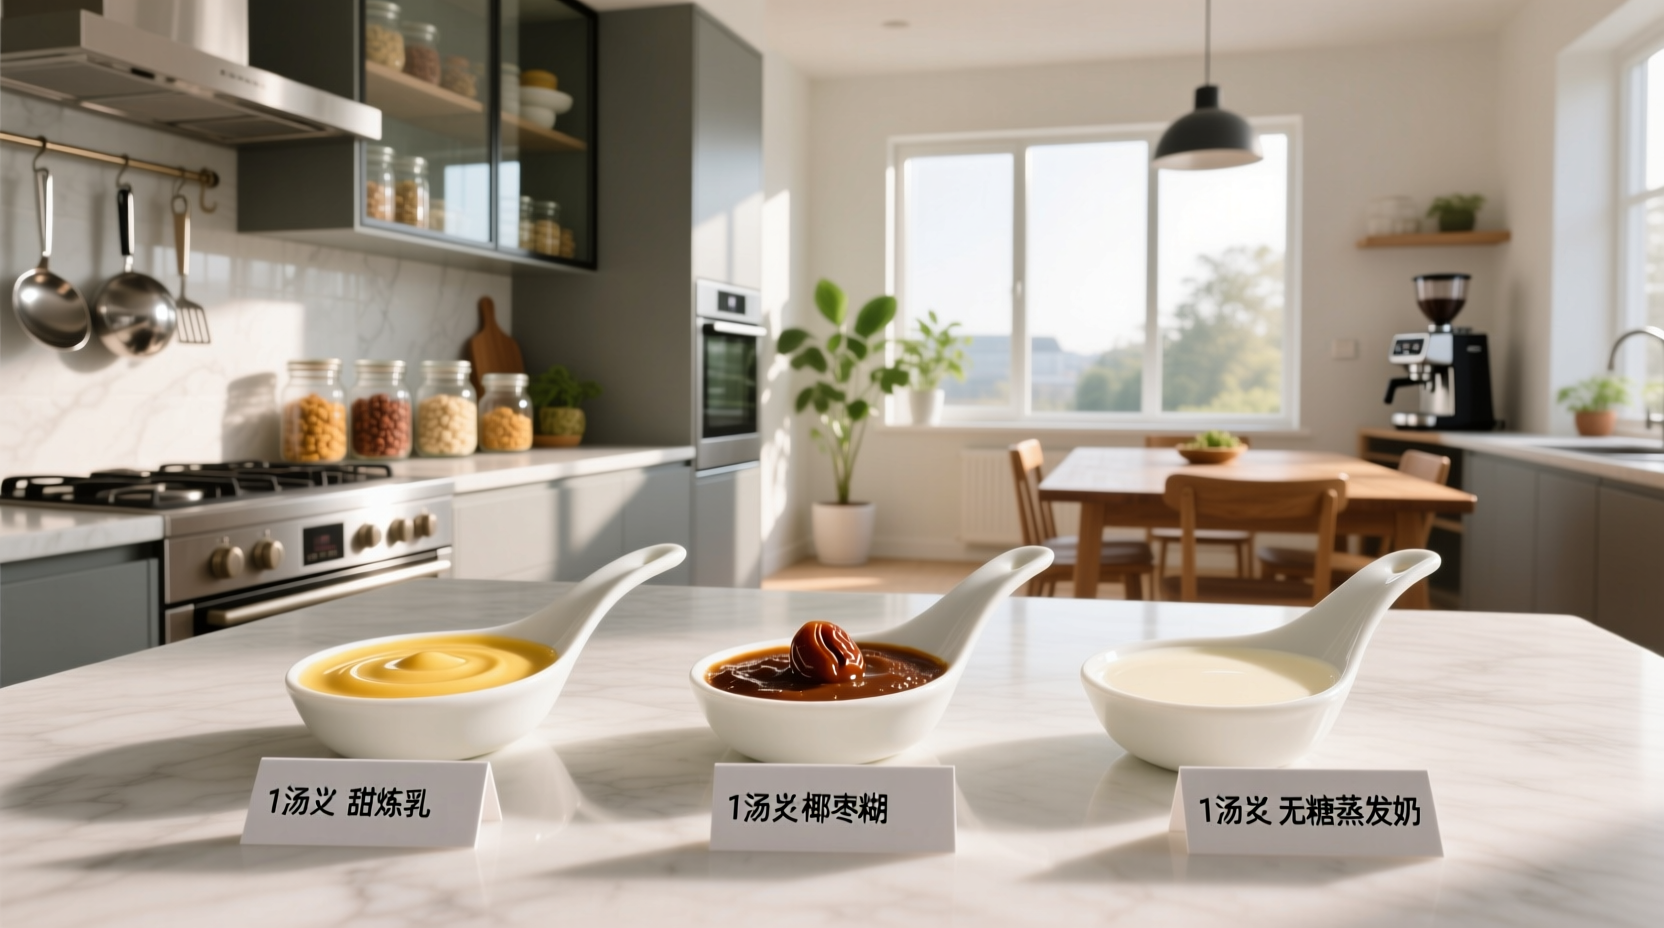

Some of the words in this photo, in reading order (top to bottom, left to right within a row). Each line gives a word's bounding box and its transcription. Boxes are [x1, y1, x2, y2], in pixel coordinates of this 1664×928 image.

[346, 786, 431, 818] 甜炼乳
[1278, 793, 1421, 827] 无糖蒸发奶
